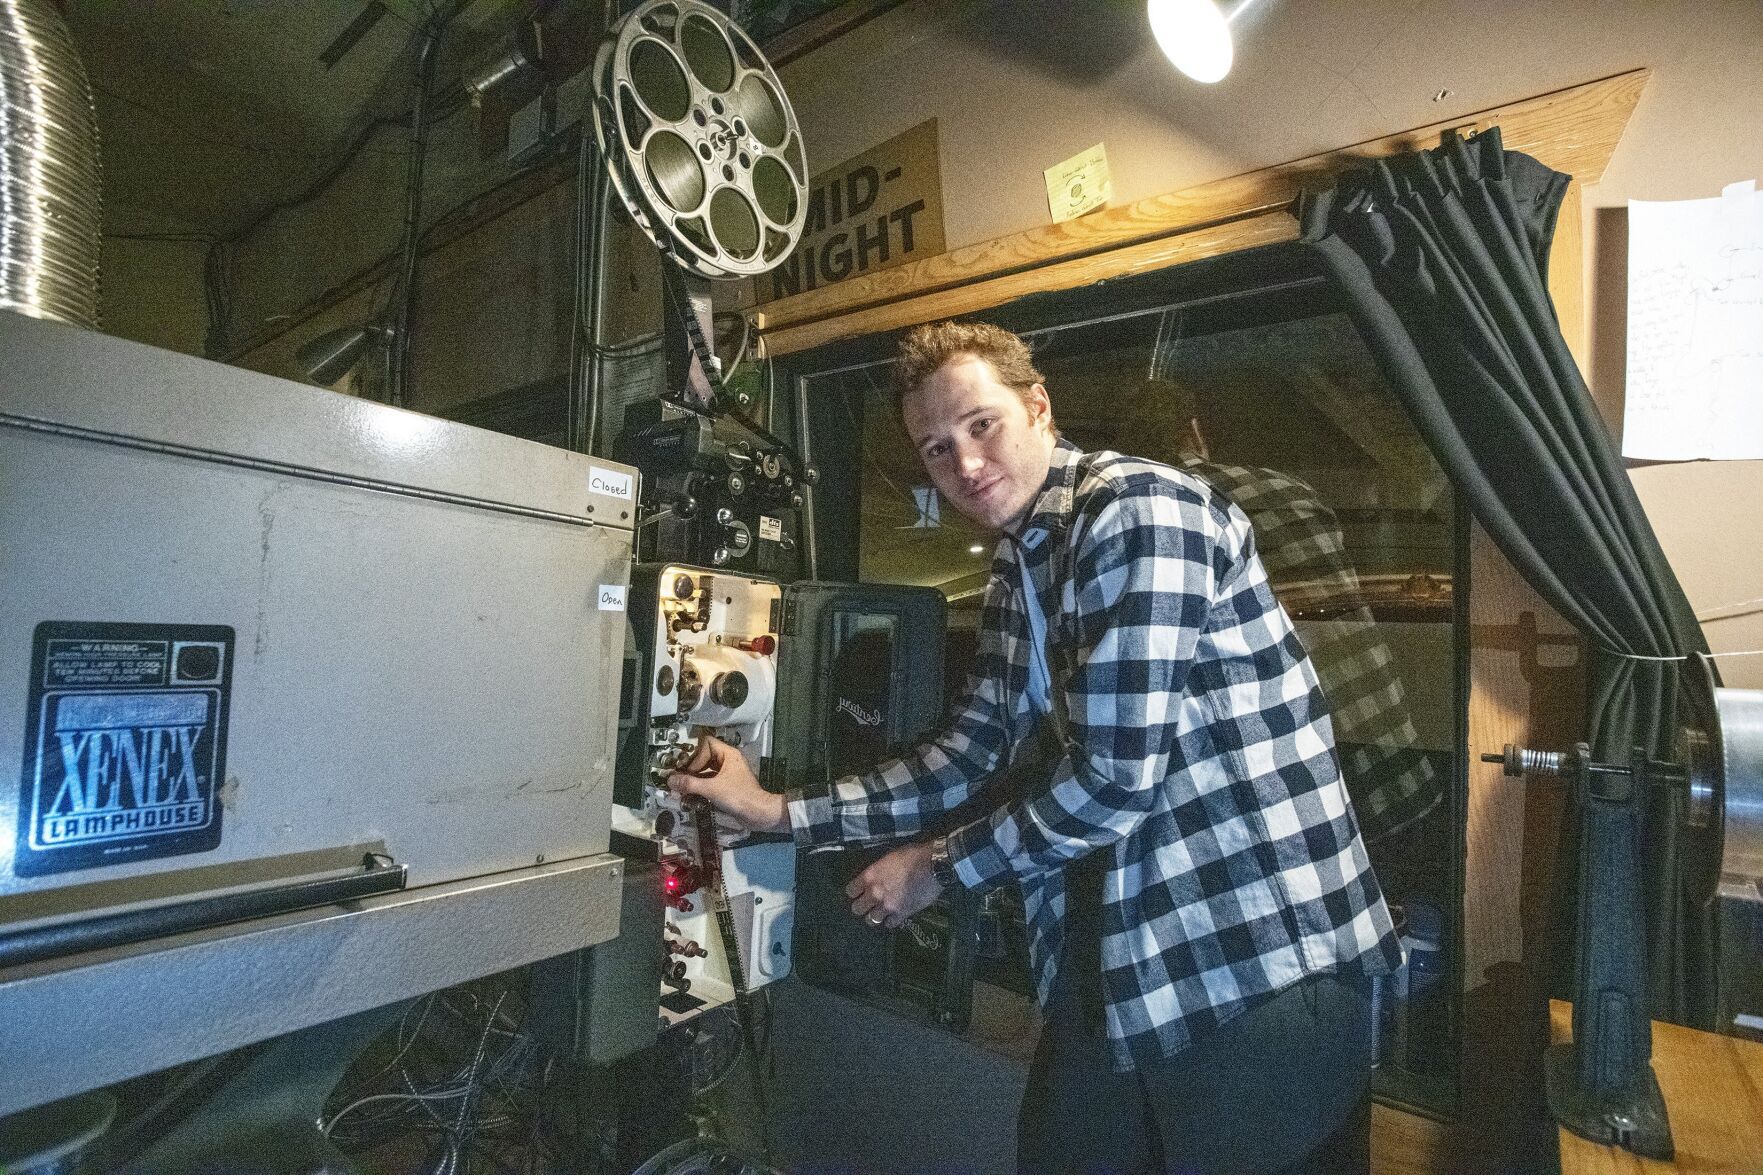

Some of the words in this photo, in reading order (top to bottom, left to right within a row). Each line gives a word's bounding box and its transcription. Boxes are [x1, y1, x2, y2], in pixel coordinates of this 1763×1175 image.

[771, 199, 926, 298] NIGHT
[591, 477, 628, 495] Closed
[601, 592, 623, 606] Open
[43, 725, 206, 818] XENEX
[51, 805, 199, 838] LAMPHOUSE
